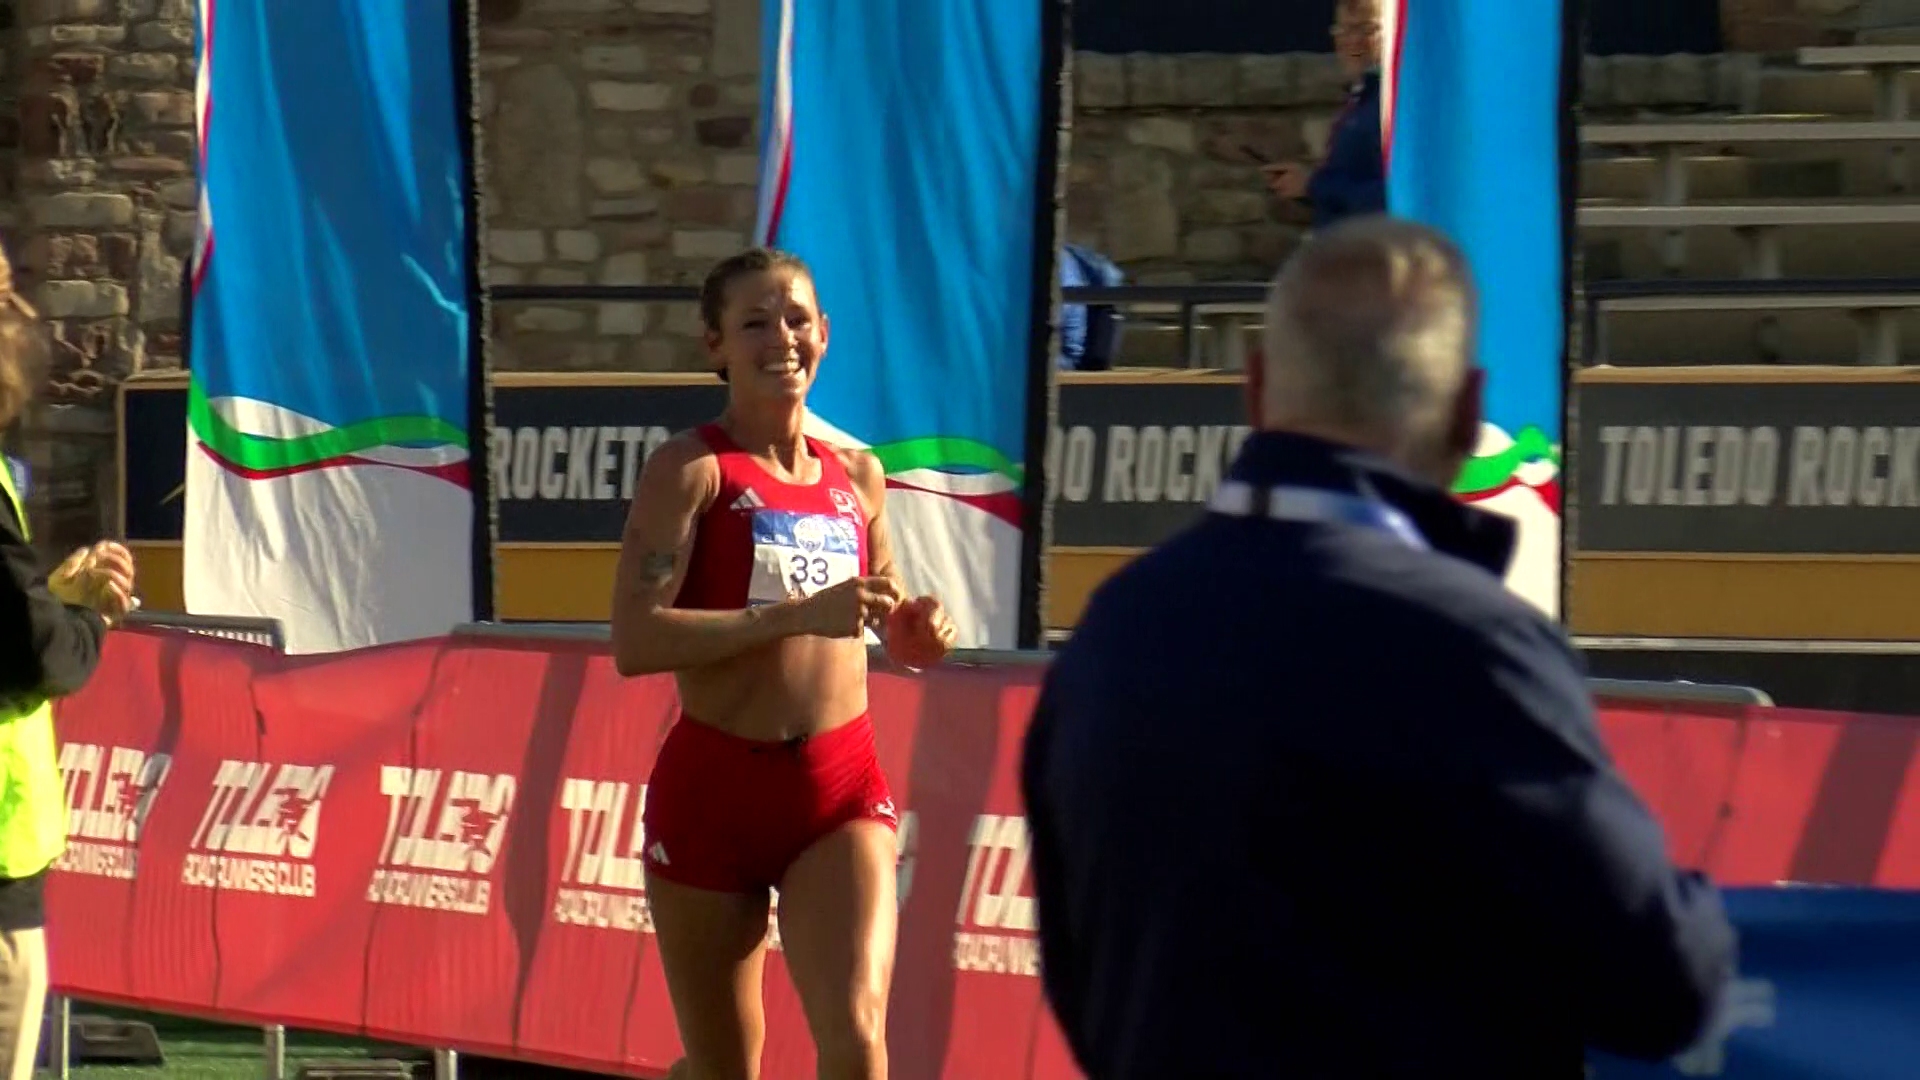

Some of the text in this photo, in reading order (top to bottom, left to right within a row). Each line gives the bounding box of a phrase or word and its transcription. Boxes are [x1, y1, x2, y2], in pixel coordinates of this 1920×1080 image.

[492, 426, 671, 499] ROCKET
[1599, 426, 1779, 505] TOLEDO
[791, 555, 829, 586] 33
[190, 760, 335, 859] TOLEDO
[378, 765, 516, 874] TOLEDO
[277, 861, 316, 898] CLUB
